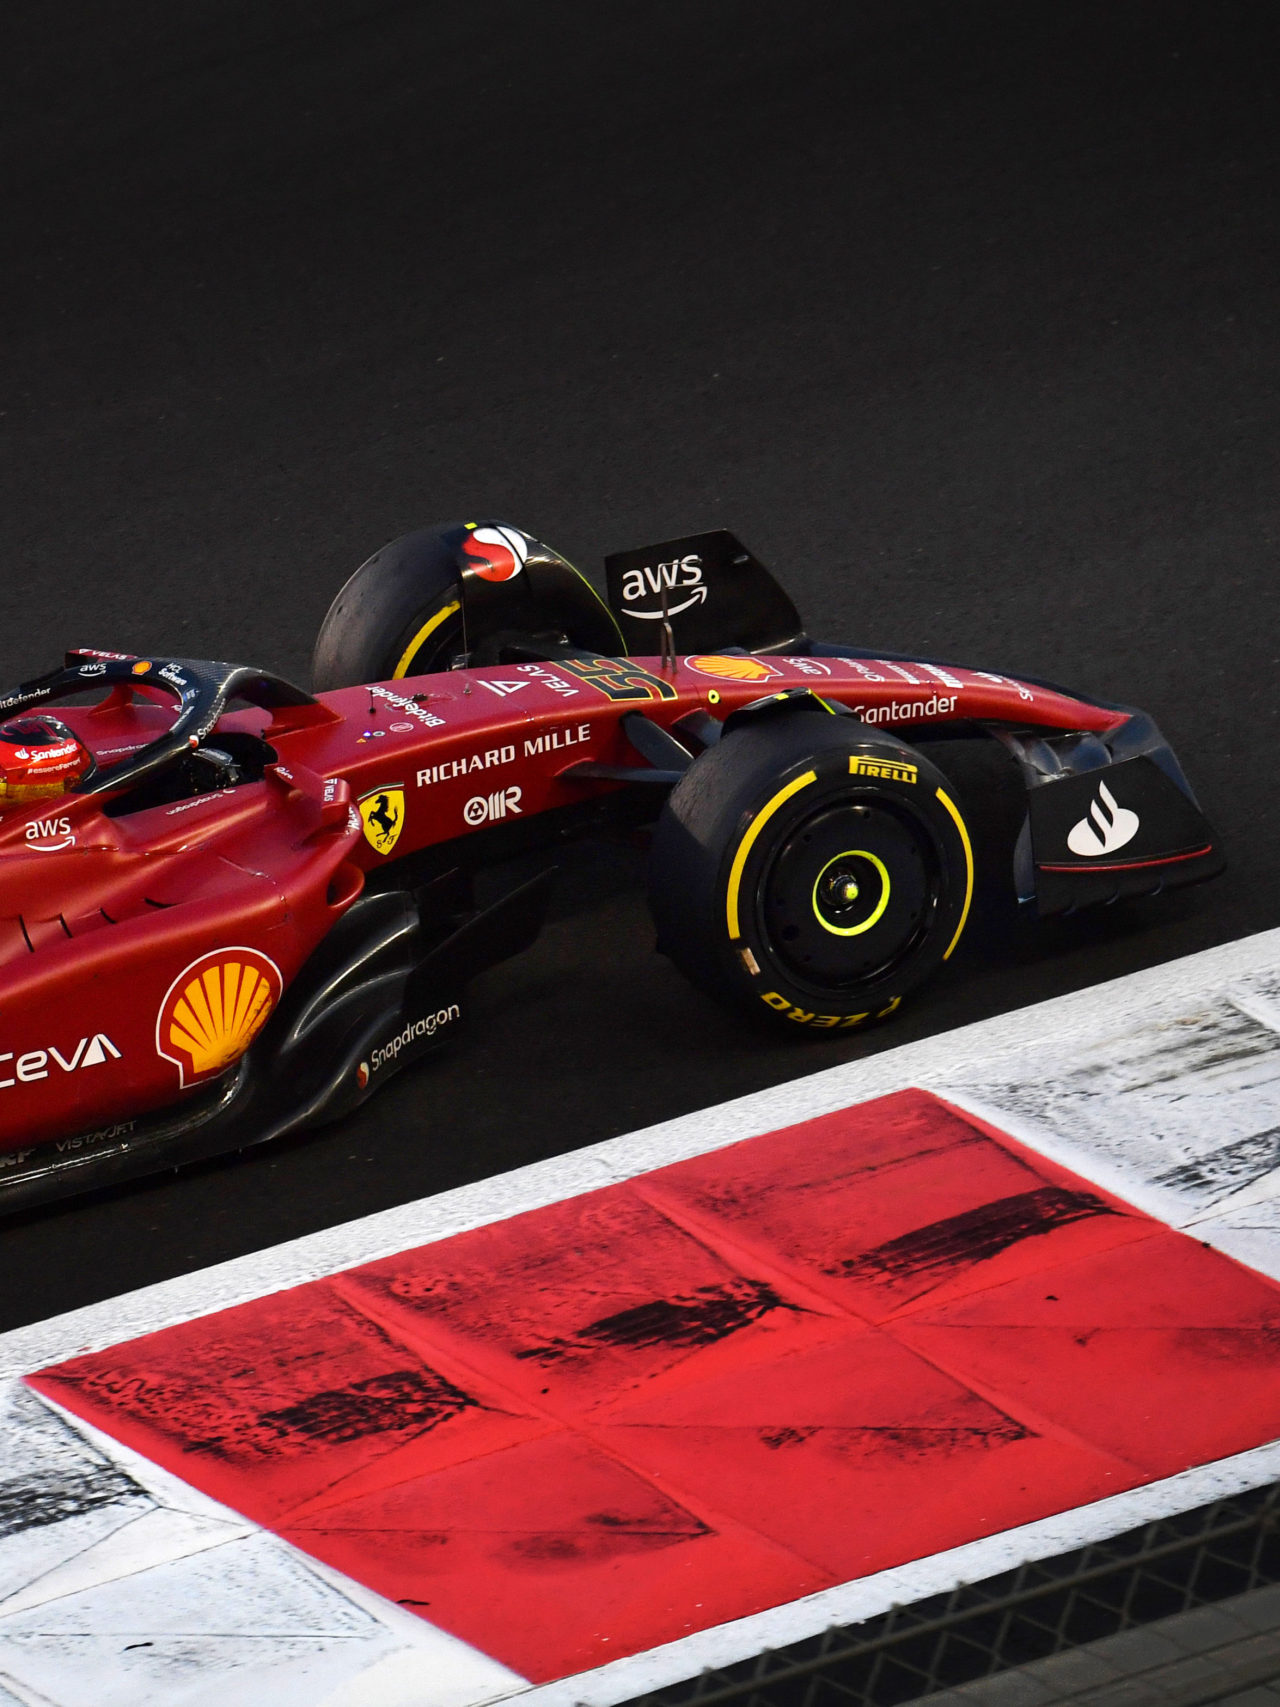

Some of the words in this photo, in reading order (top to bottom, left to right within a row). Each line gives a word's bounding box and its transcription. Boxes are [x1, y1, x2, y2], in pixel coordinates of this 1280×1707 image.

[622, 554, 702, 601] aws
[79, 663, 107, 673] aws
[91, 650, 128, 661] VELAS
[516, 664, 579, 697] VELAS
[365, 686, 446, 728] Bitdefender
[854, 696, 958, 724] Santander
[30, 742, 78, 761] Santander
[416, 745, 516, 787] RICHARD
[524, 723, 591, 757] MILLE
[848, 755, 918, 785] PIRELLI
[24, 817, 71, 840] aws
[760, 991, 870, 1028] ZERO
[371, 1003, 461, 1072] Snapdragon
